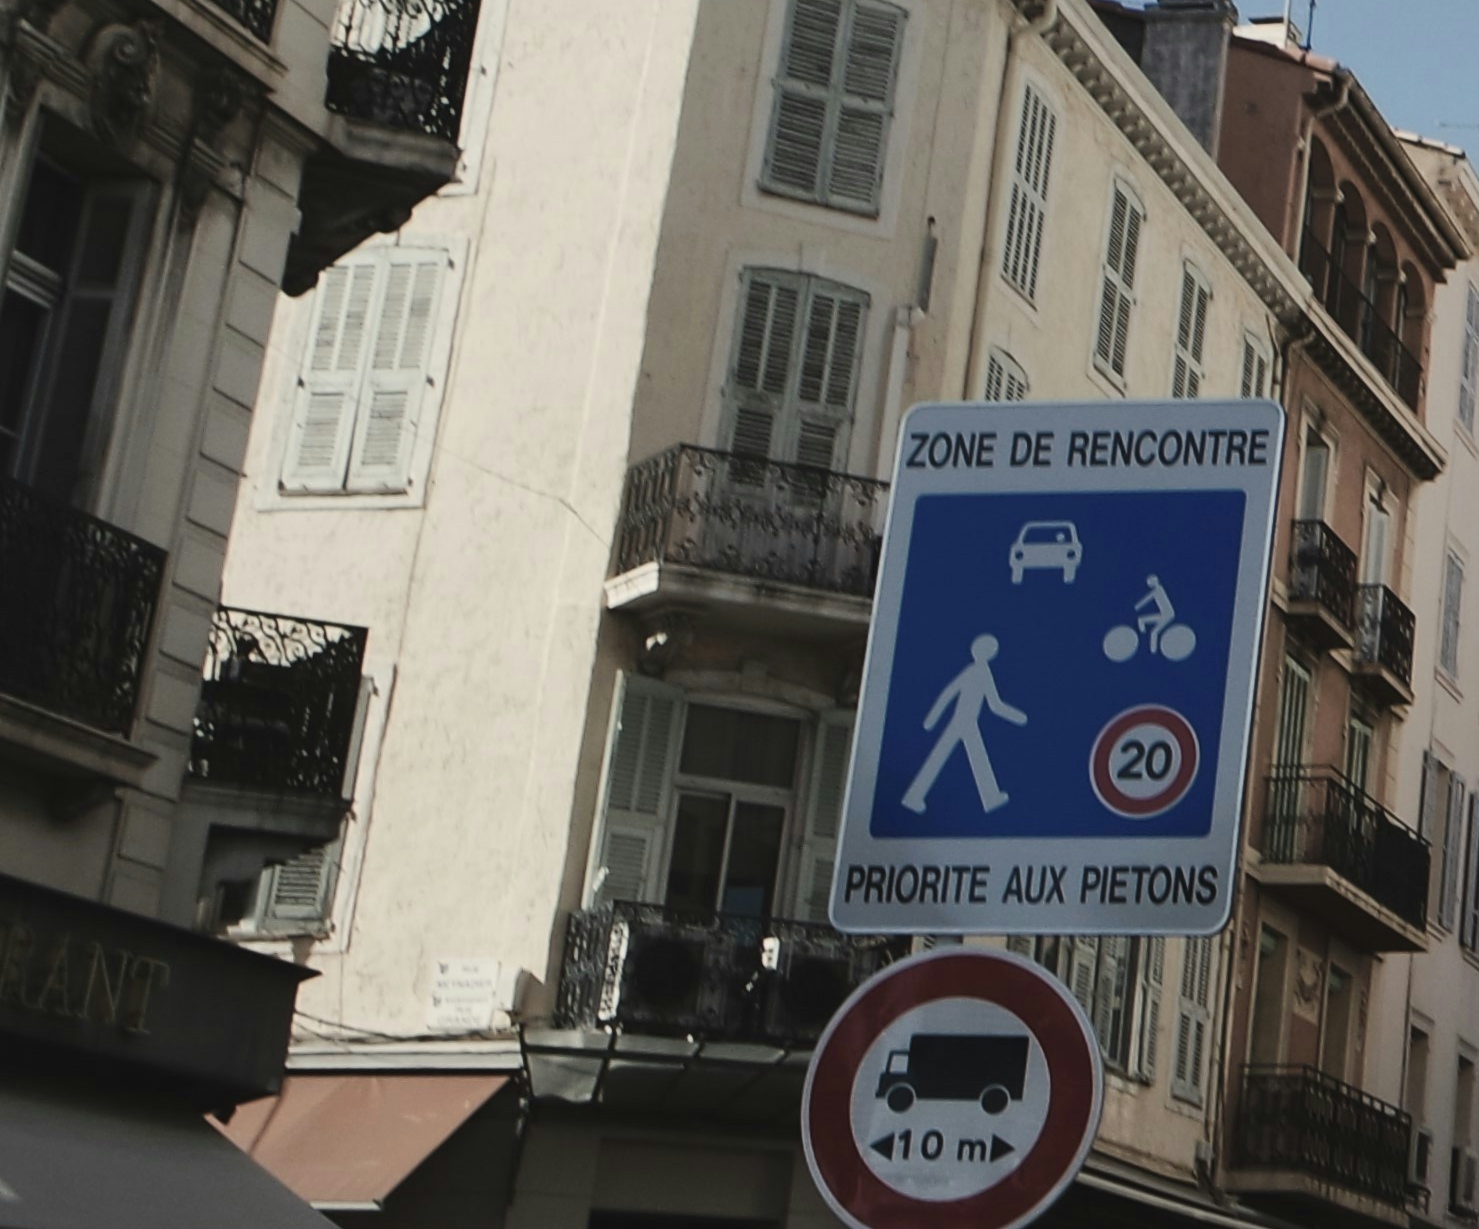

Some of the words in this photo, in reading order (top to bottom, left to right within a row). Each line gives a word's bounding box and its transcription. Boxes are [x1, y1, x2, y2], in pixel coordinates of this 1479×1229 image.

[907, 432, 998, 470] ZONE
[1009, 431, 1055, 468] DE
[1067, 429, 1270, 468] RENCONTRE
[1116, 739, 1173, 782] 20
[843, 863, 991, 906] PRIORITE
[1001, 865, 1068, 905] AUX
[1079, 864, 1219, 907] PIETONS
[898, 1128, 945, 1161] 10
[956, 1138, 988, 1163] m
